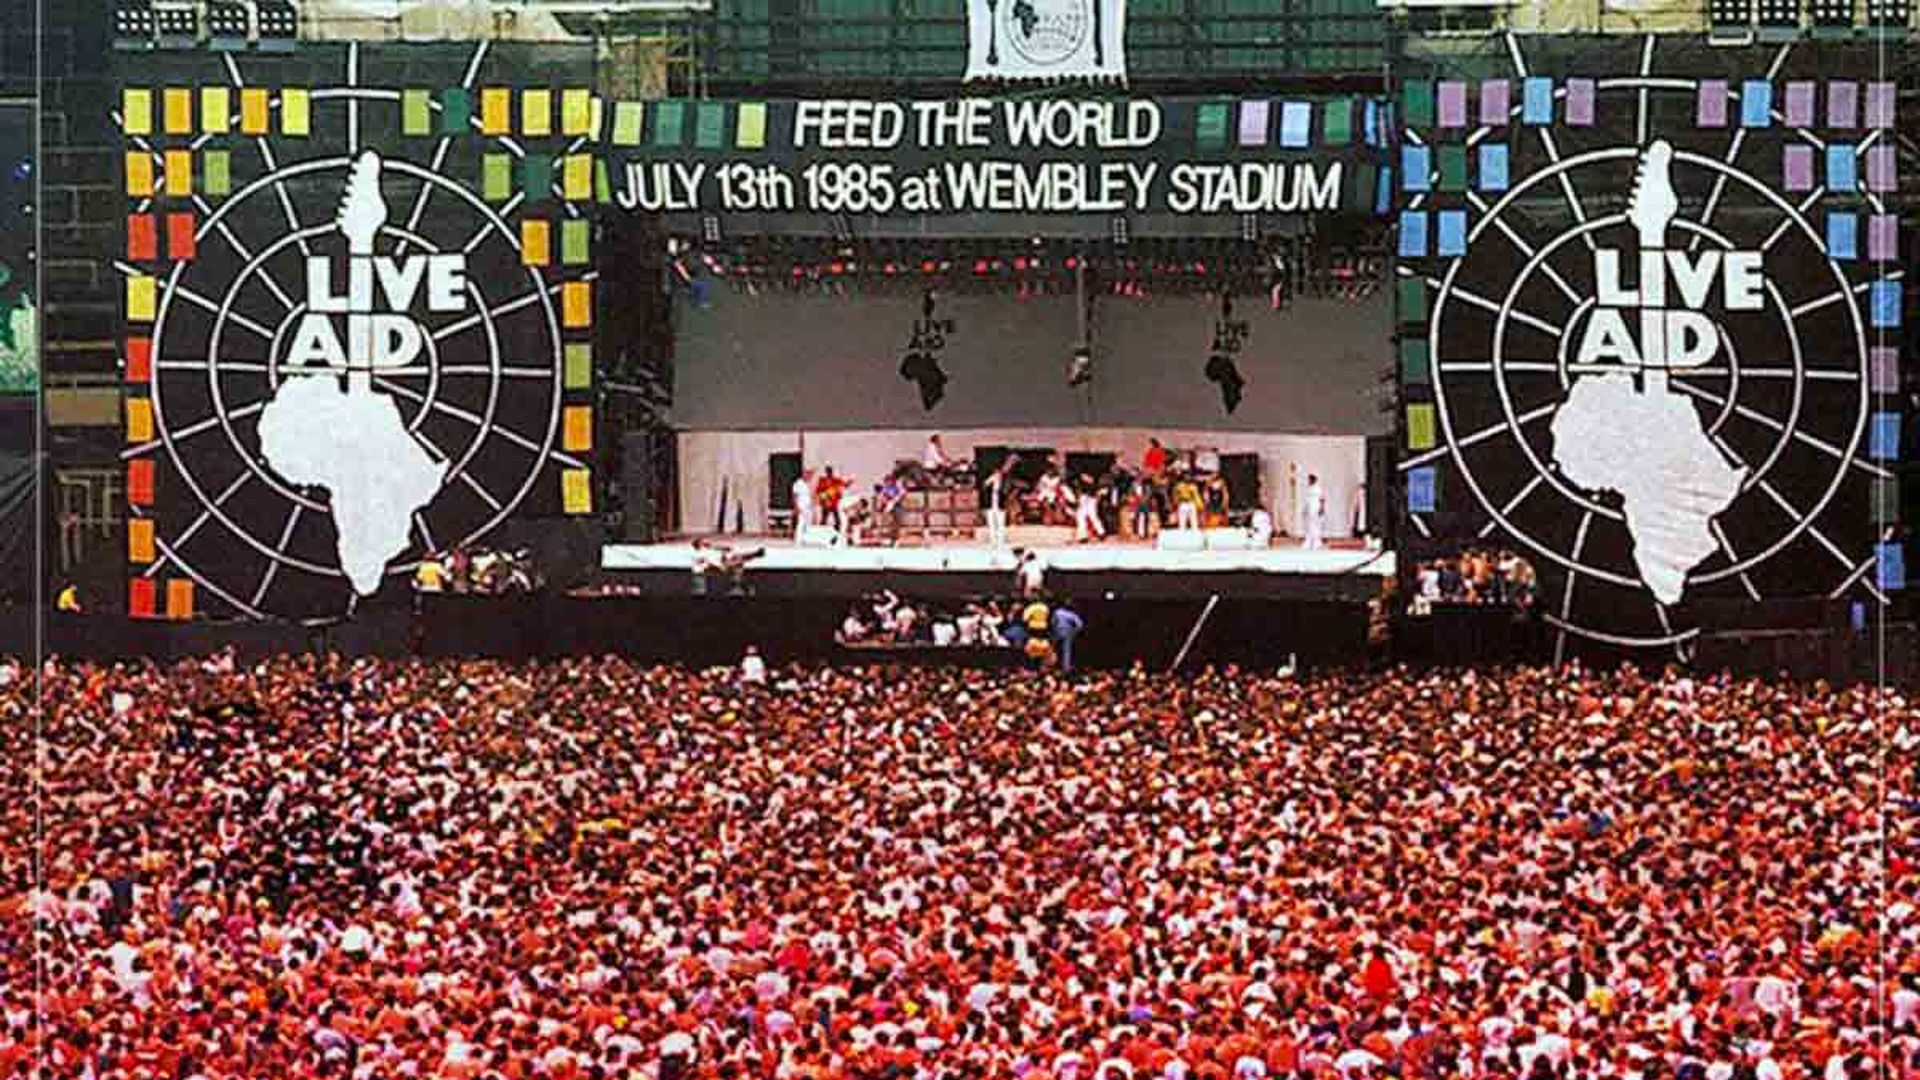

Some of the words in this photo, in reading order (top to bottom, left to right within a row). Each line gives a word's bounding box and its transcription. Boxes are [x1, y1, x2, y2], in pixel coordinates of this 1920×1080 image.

[794, 101, 902, 147] FEED
[914, 101, 990, 146] THE
[1005, 101, 1160, 146] WORLD
[617, 164, 704, 210] JULY
[715, 163, 793, 209] 13th
[803, 163, 892, 209] 1985
[901, 174, 941, 209] at
[946, 163, 1154, 209] WEMBLEY
[1168, 162, 1342, 210] STADIUM
[308, 255, 466, 311] LIVE
[1596, 250, 1764, 309] LIVE
[287, 314, 422, 367] AID
[1577, 309, 1719, 366] AID
